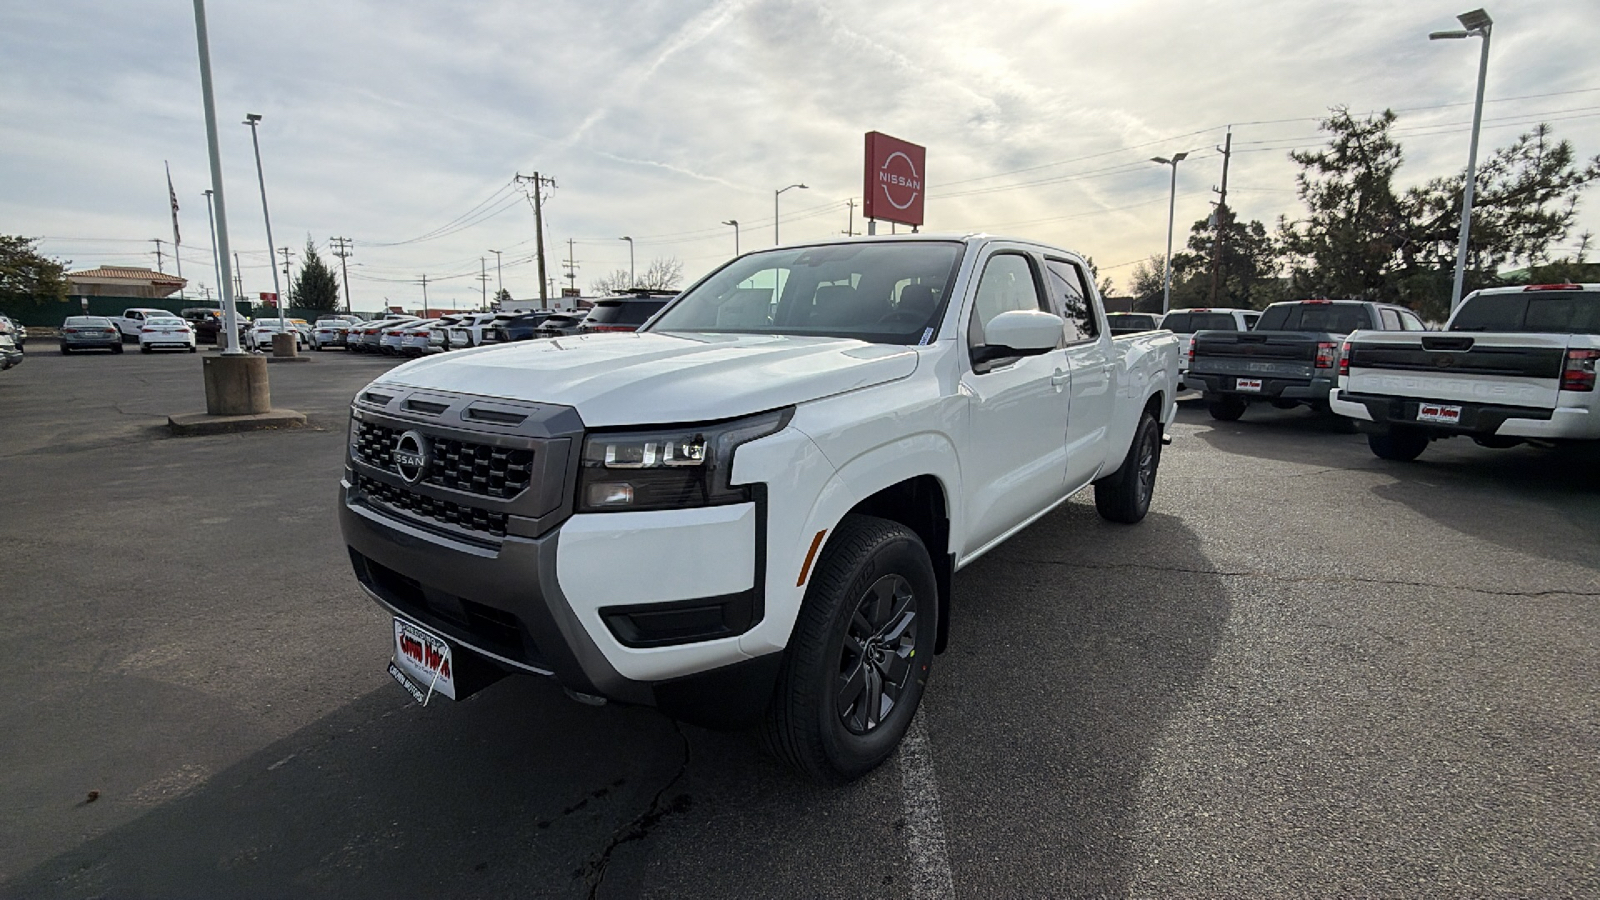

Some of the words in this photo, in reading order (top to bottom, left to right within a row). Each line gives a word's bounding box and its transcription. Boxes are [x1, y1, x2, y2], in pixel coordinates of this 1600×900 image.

[879, 171, 920, 190] NISSAN
[395, 454, 424, 466] SSAN
[389, 665, 406, 685] CROWN
[404, 680, 425, 703] MOTORS
